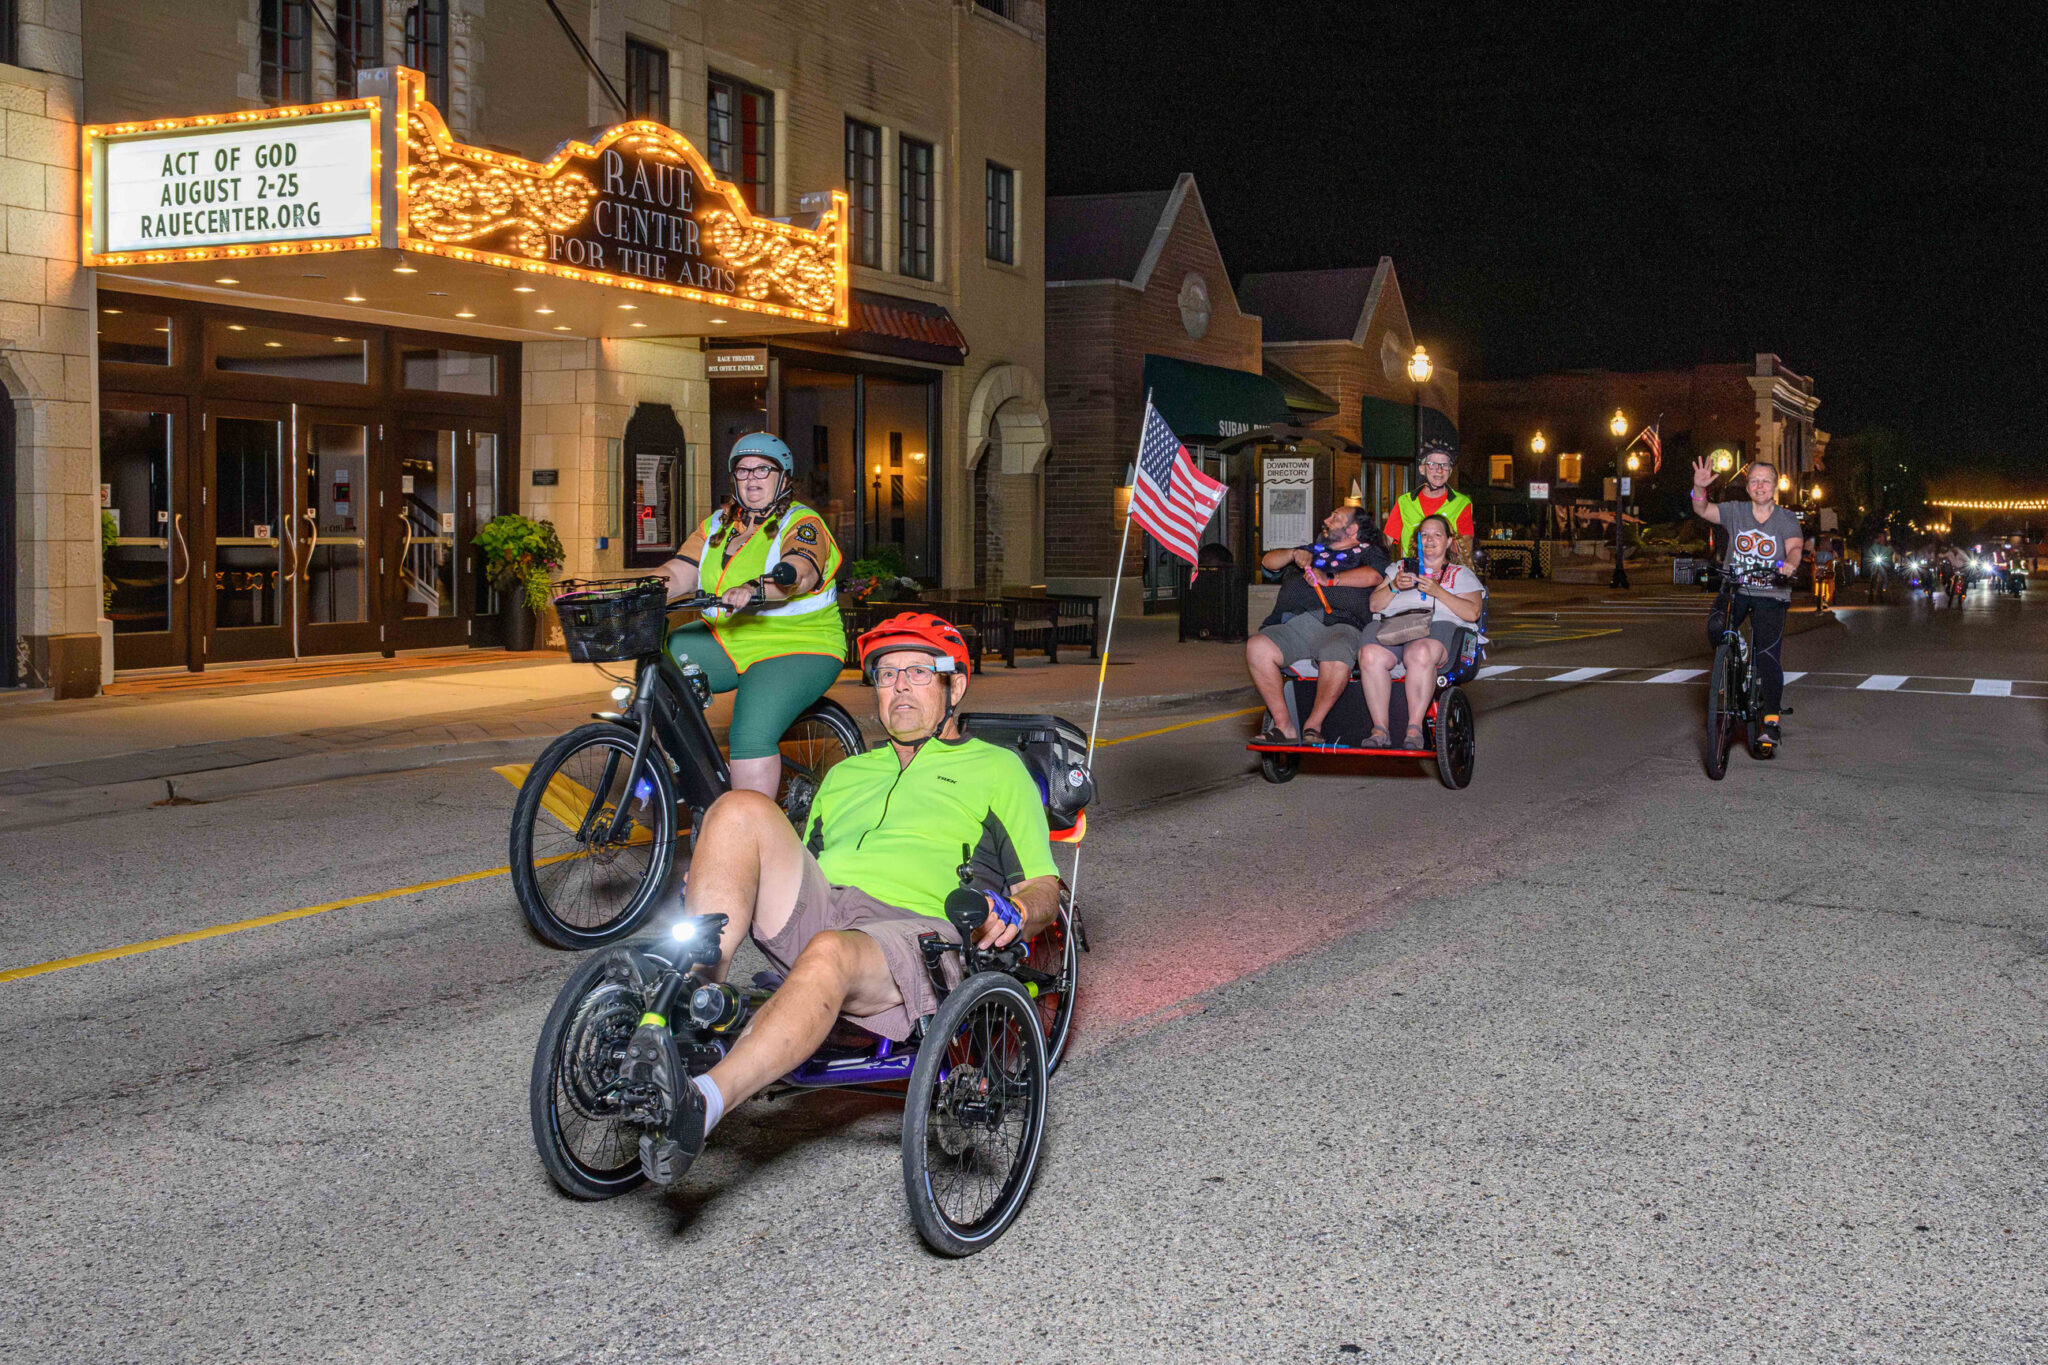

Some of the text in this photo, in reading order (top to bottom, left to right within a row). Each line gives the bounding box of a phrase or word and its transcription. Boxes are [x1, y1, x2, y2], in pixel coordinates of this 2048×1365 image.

[162, 142, 297, 177] ACT OF GOD
[161, 173, 299, 207] AUGUST 2-25
[603, 150, 694, 213] RAUE
[141, 202, 321, 239] RAUECENTER.ORG
[593, 200, 702, 256] CENTER
[549, 233, 736, 293] FOR THE ARTS
[1267, 469, 1308, 477] DIRECTORY
[936, 775, 958, 784] TREK
